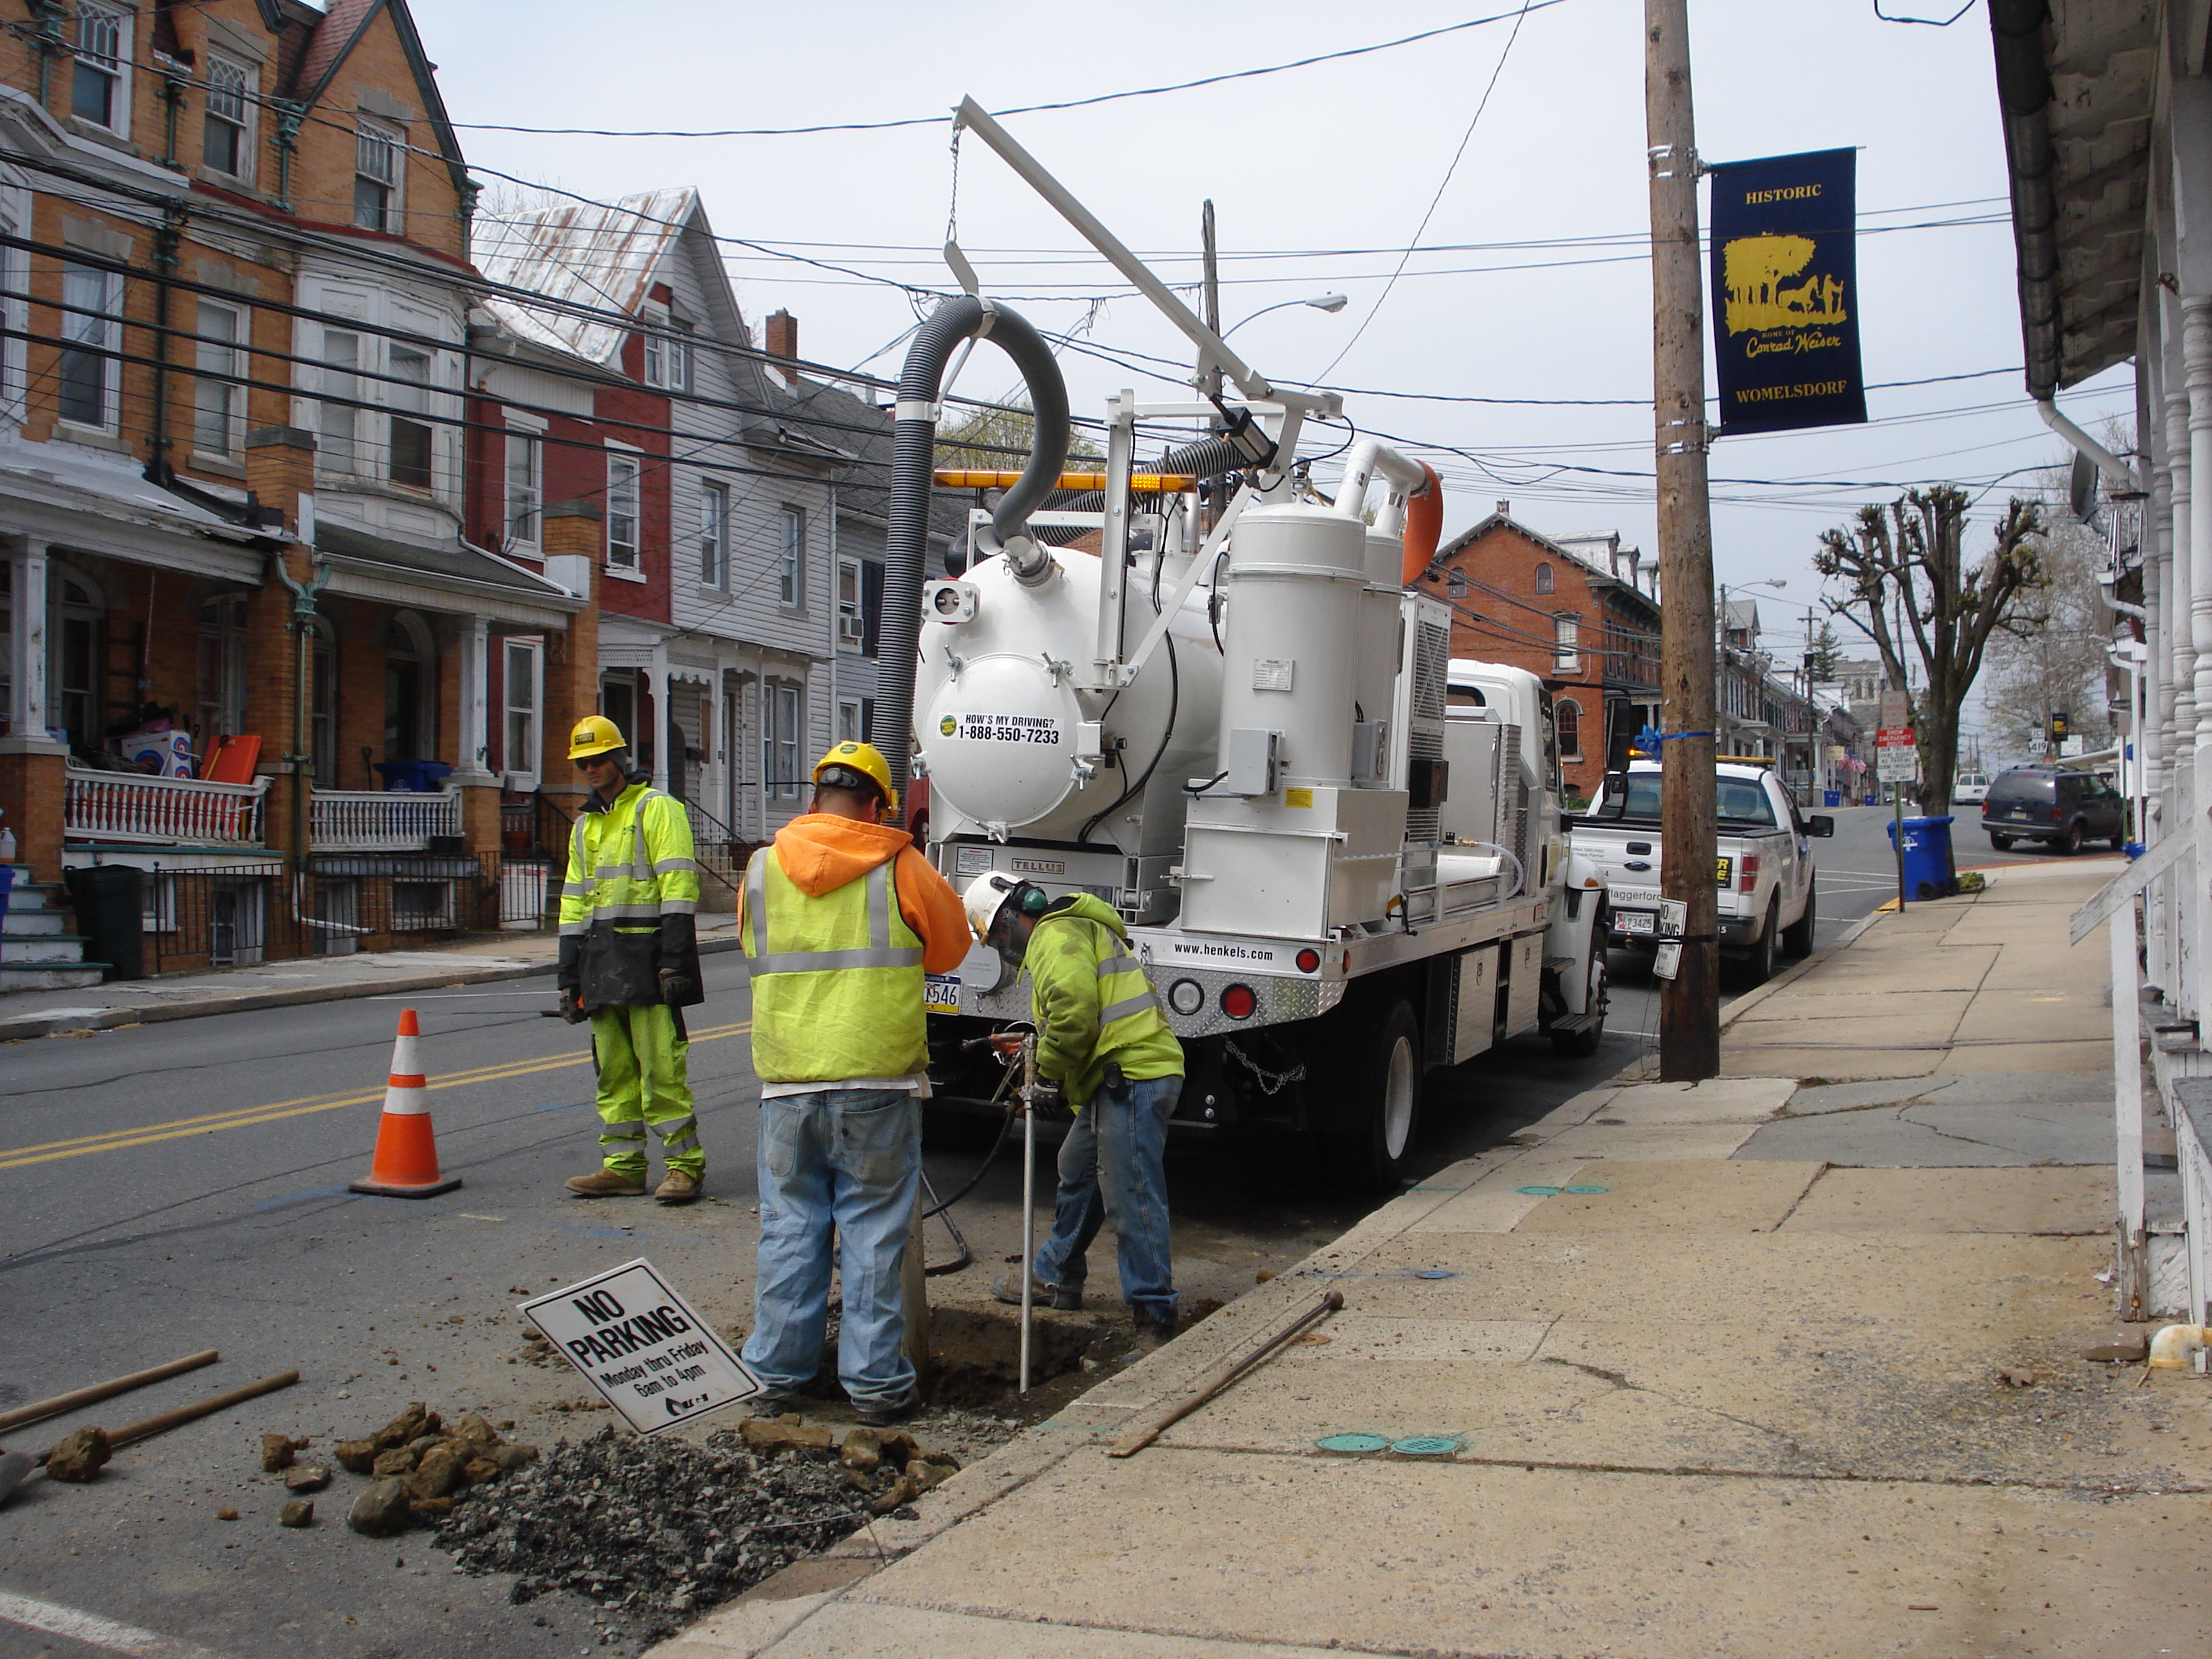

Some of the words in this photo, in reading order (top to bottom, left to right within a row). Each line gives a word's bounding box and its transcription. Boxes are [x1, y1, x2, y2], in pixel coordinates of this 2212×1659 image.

[1745, 184, 1822, 204] HISTORIC
[1746, 336, 1794, 358] Conrad
[1794, 326, 1841, 355] Weiser
[1735, 379, 1848, 403] WOMELSDORF
[966, 714, 993, 724] HOW'S
[995, 716, 1010, 726] MY
[1012, 716, 1054, 729] DRIVING?
[958, 725, 1059, 745] 1-888-550-7233
[2031, 742, 2046, 751] 419
[1014, 860, 1062, 872] TELLUS
[1660, 922, 1679, 936] KING
[1174, 943, 1273, 961] www.henkels.com
[572, 1290, 625, 1326] NO
[567, 1305, 692, 1368] PARKING
[599, 1364, 648, 1388] Monday
[643, 1355, 673, 1372] thru
[667, 1341, 709, 1362] Friday
[633, 1380, 665, 1398] 6am
[660, 1375, 678, 1388] to
[675, 1364, 706, 1382] 4pm
